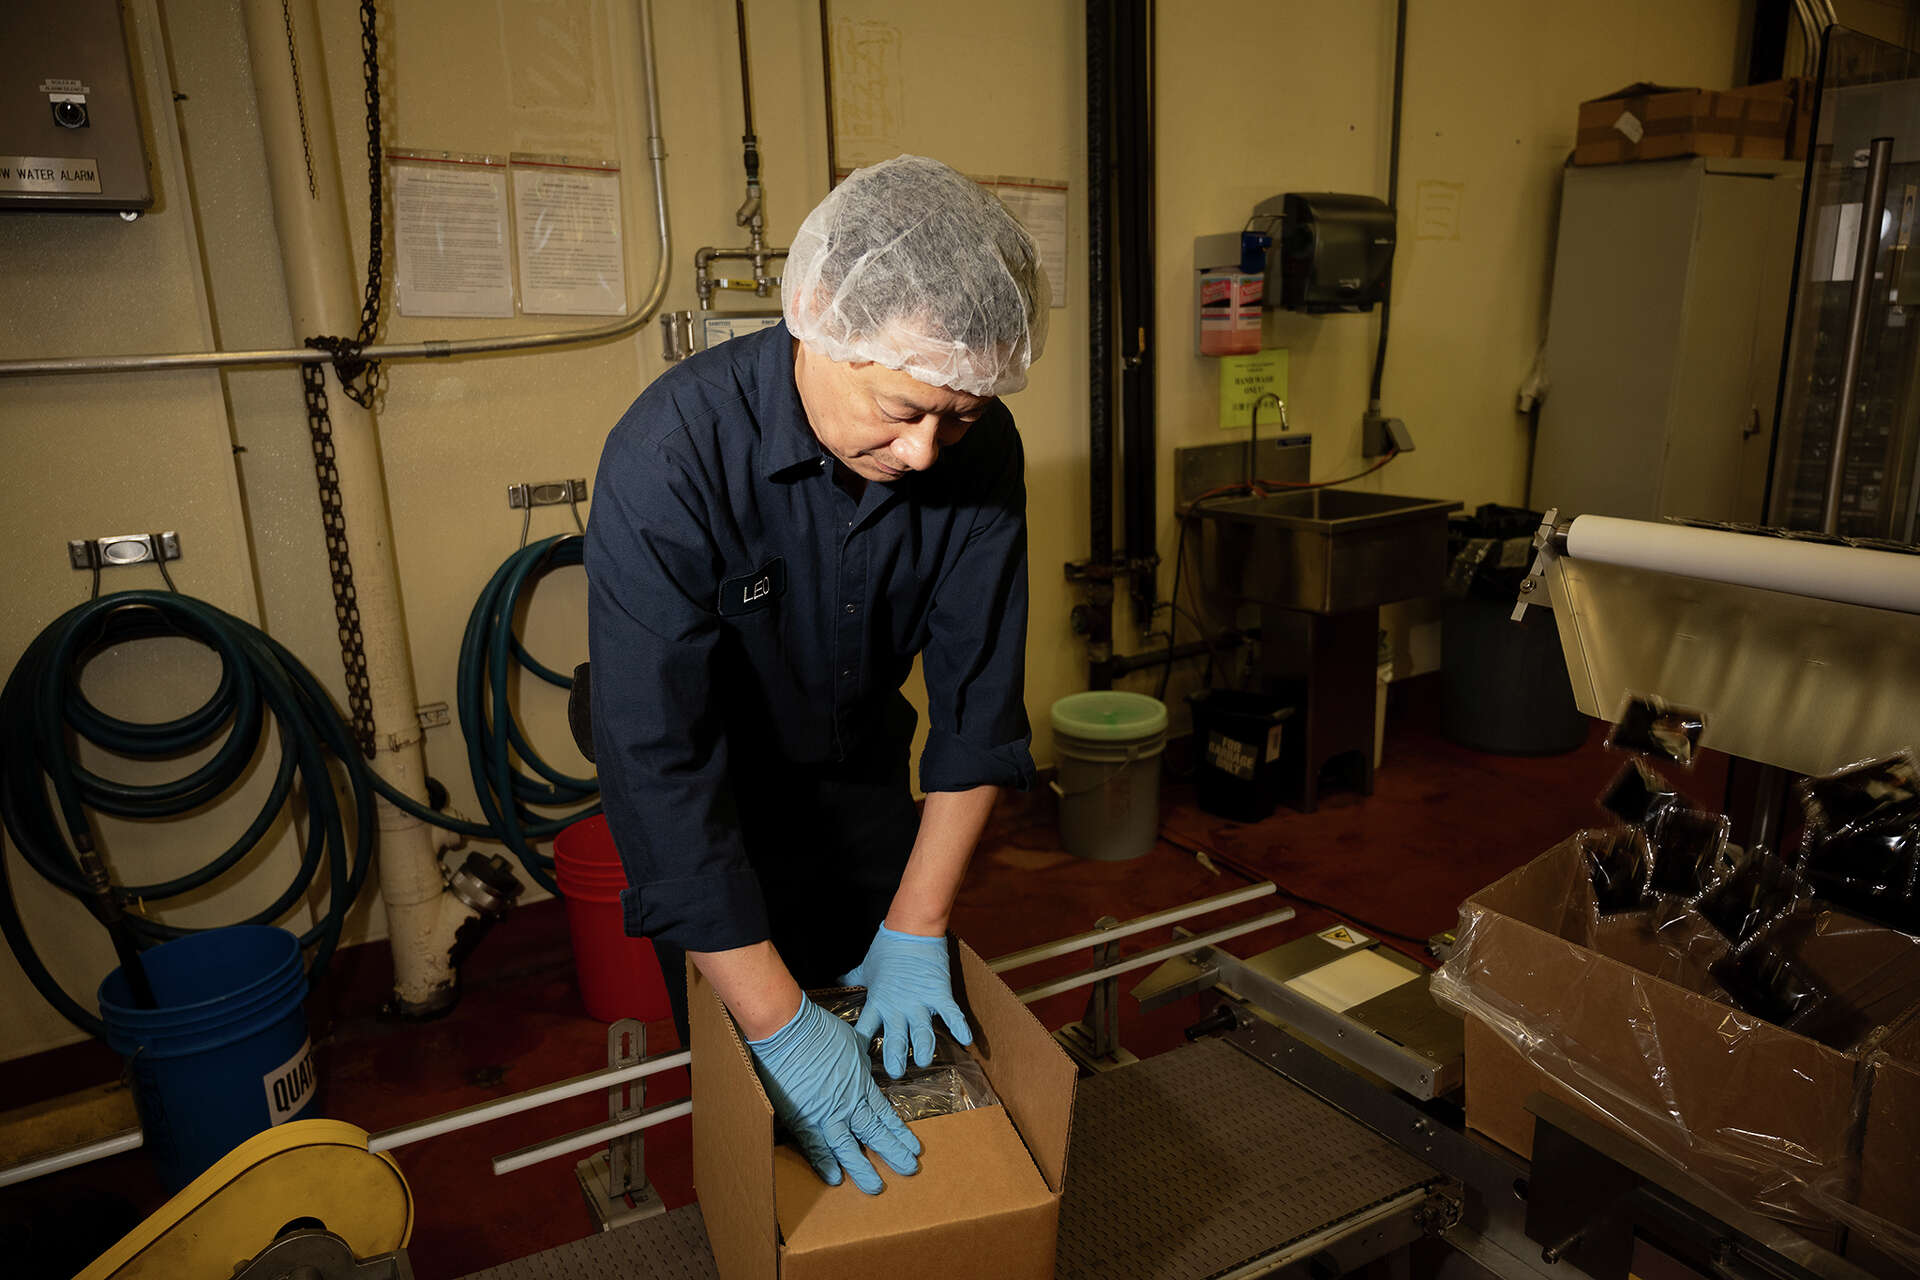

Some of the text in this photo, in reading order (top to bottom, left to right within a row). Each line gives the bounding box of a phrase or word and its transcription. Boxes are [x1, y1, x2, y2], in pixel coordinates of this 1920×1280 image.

[16, 168, 55, 180] WATER
[61, 170, 96, 181] ALARM
[743, 576, 770, 603] LEO
